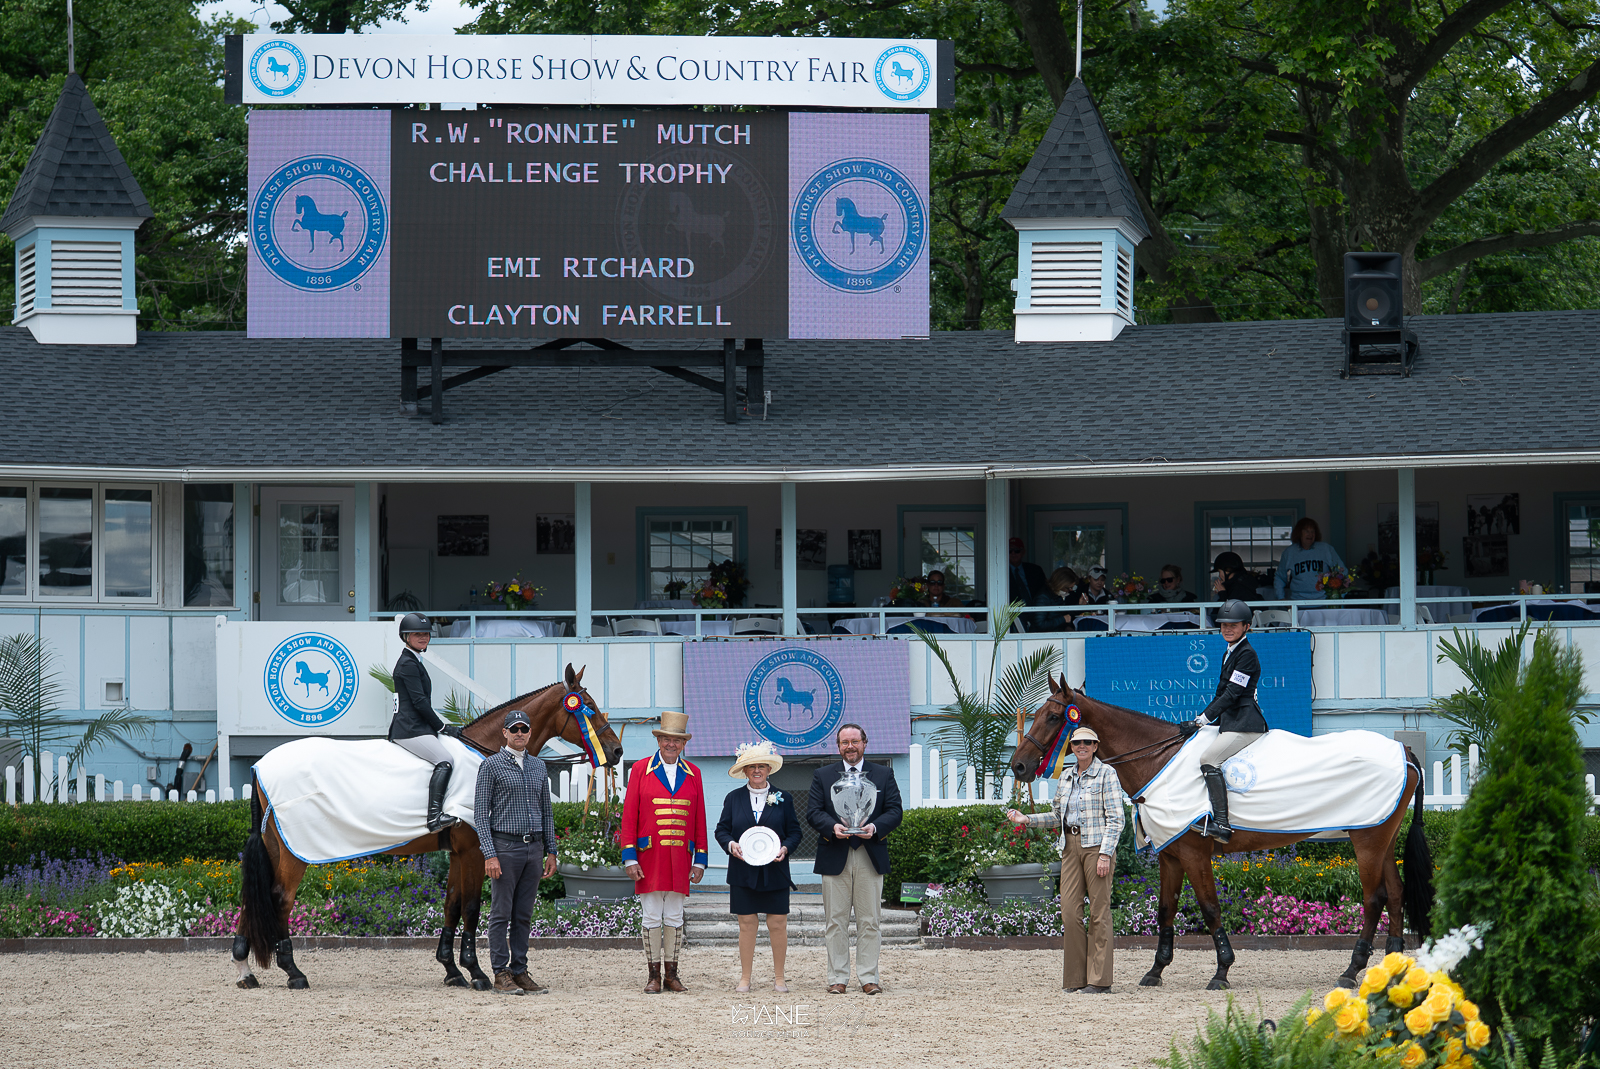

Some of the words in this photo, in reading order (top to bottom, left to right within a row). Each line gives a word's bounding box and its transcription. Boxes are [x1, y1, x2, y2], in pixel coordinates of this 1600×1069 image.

[312, 54, 416, 80] DEVON
[426, 54, 522, 80] HORSE
[532, 54, 620, 80] SHOW
[626, 55, 650, 81] &
[656, 56, 800, 81] COUNTRY
[808, 58, 870, 83] FAIR
[412, 122, 480, 144] R.W.
[489, 118, 636, 144] "RONNIE"
[657, 124, 750, 144] MUTCH
[286, 162, 322, 180] SHOW
[328, 164, 353, 178] AND
[430, 162, 600, 183] CHALLENGE
[618, 163, 734, 184] TROPHY
[826, 165, 862, 182] SHOW
[868, 166, 892, 181] AND
[258, 178, 284, 219] HORSE
[356, 178, 380, 235] COUNTRY
[800, 180, 824, 220] HORSE
[895, 182, 920, 237] COUNTRY
[258, 224, 280, 266] DEVON
[358, 238, 378, 266] FAIR
[798, 226, 821, 268] DEVON
[897, 241, 916, 268] FAIR
[488, 257, 541, 278] EMI
[563, 257, 694, 278] RICHARD
[306, 276, 332, 284] 1896
[846, 278, 872, 286] 1896
[448, 304, 580, 326] CLAYTON
[602, 305, 732, 326] FARRELL
[1294, 560, 1324, 576] DEVON
[286, 638, 312, 652] SHOW
[316, 639, 334, 650] AND
[1190, 640, 1205, 651] 85
[270, 650, 286, 680] HORSE
[336, 650, 353, 690] COUNTRY
[768, 652, 796, 666] SHOW
[800, 654, 819, 665] AND
[749, 665, 768, 696] HORSE
[821, 664, 840, 706] COUNTRY
[1112, 680, 1140, 692] R.W.
[270, 684, 290, 712] DEVON
[333, 692, 350, 712] FAIR
[1148, 694, 1216, 708] EQUITAT
[749, 699, 766, 730] DEVON
[824, 708, 838, 730] FAIR
